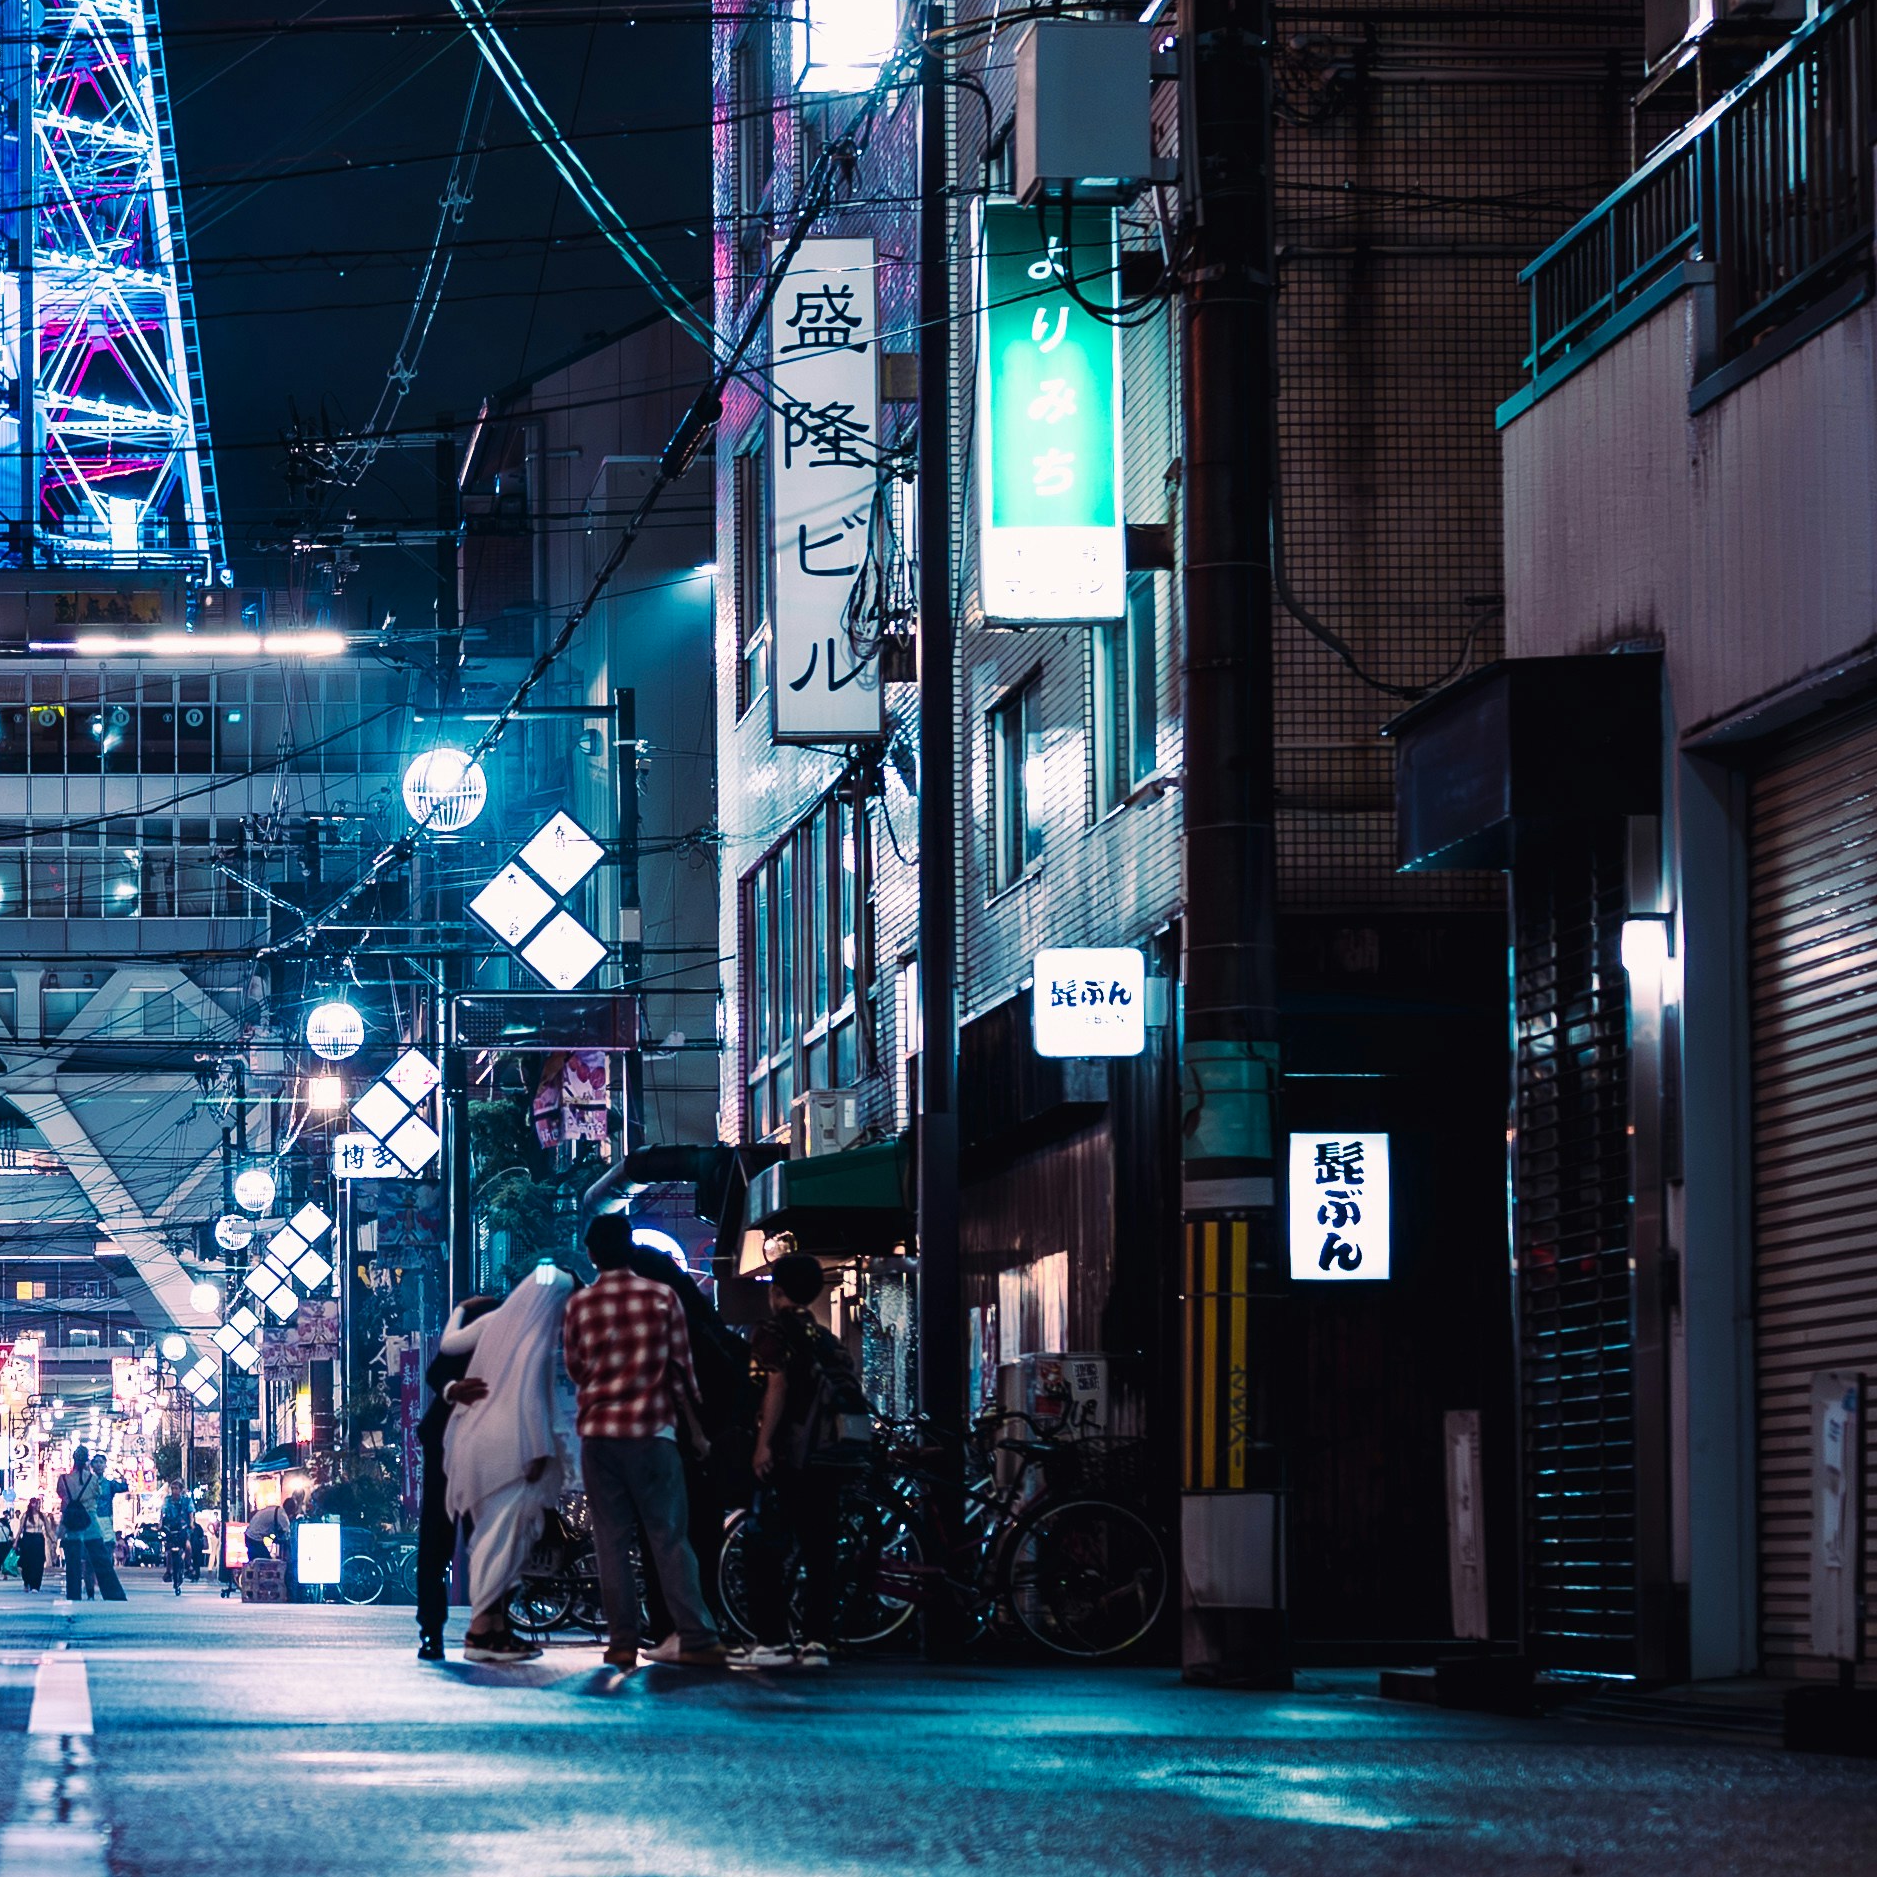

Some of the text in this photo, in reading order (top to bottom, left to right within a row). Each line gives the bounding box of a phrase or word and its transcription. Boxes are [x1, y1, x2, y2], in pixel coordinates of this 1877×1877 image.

[780, 284, 870, 692] 盛隆ビル
[1027, 236, 1079, 496] よりみち
